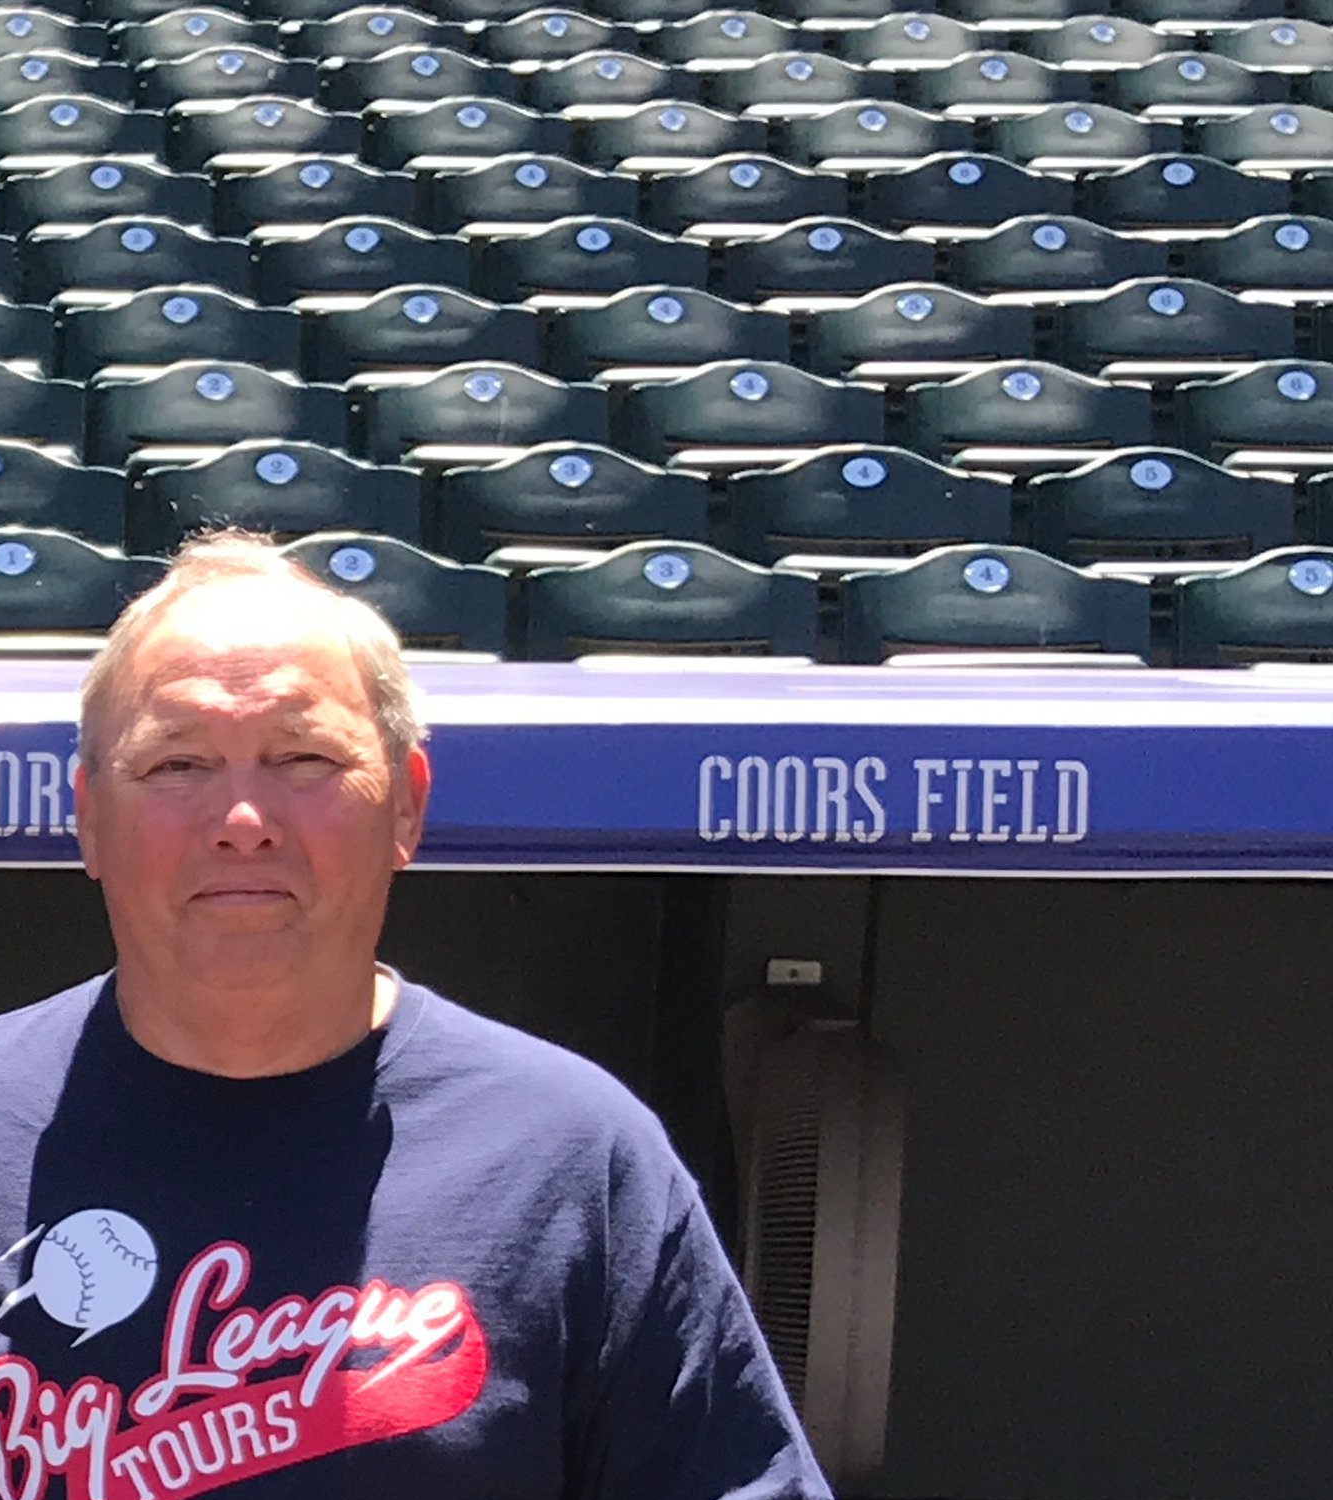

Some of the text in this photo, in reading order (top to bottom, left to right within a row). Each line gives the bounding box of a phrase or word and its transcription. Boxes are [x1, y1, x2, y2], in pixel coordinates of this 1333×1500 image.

[698, 755, 1089, 844] COORS FIELD
[133, 1245, 465, 1417] League
